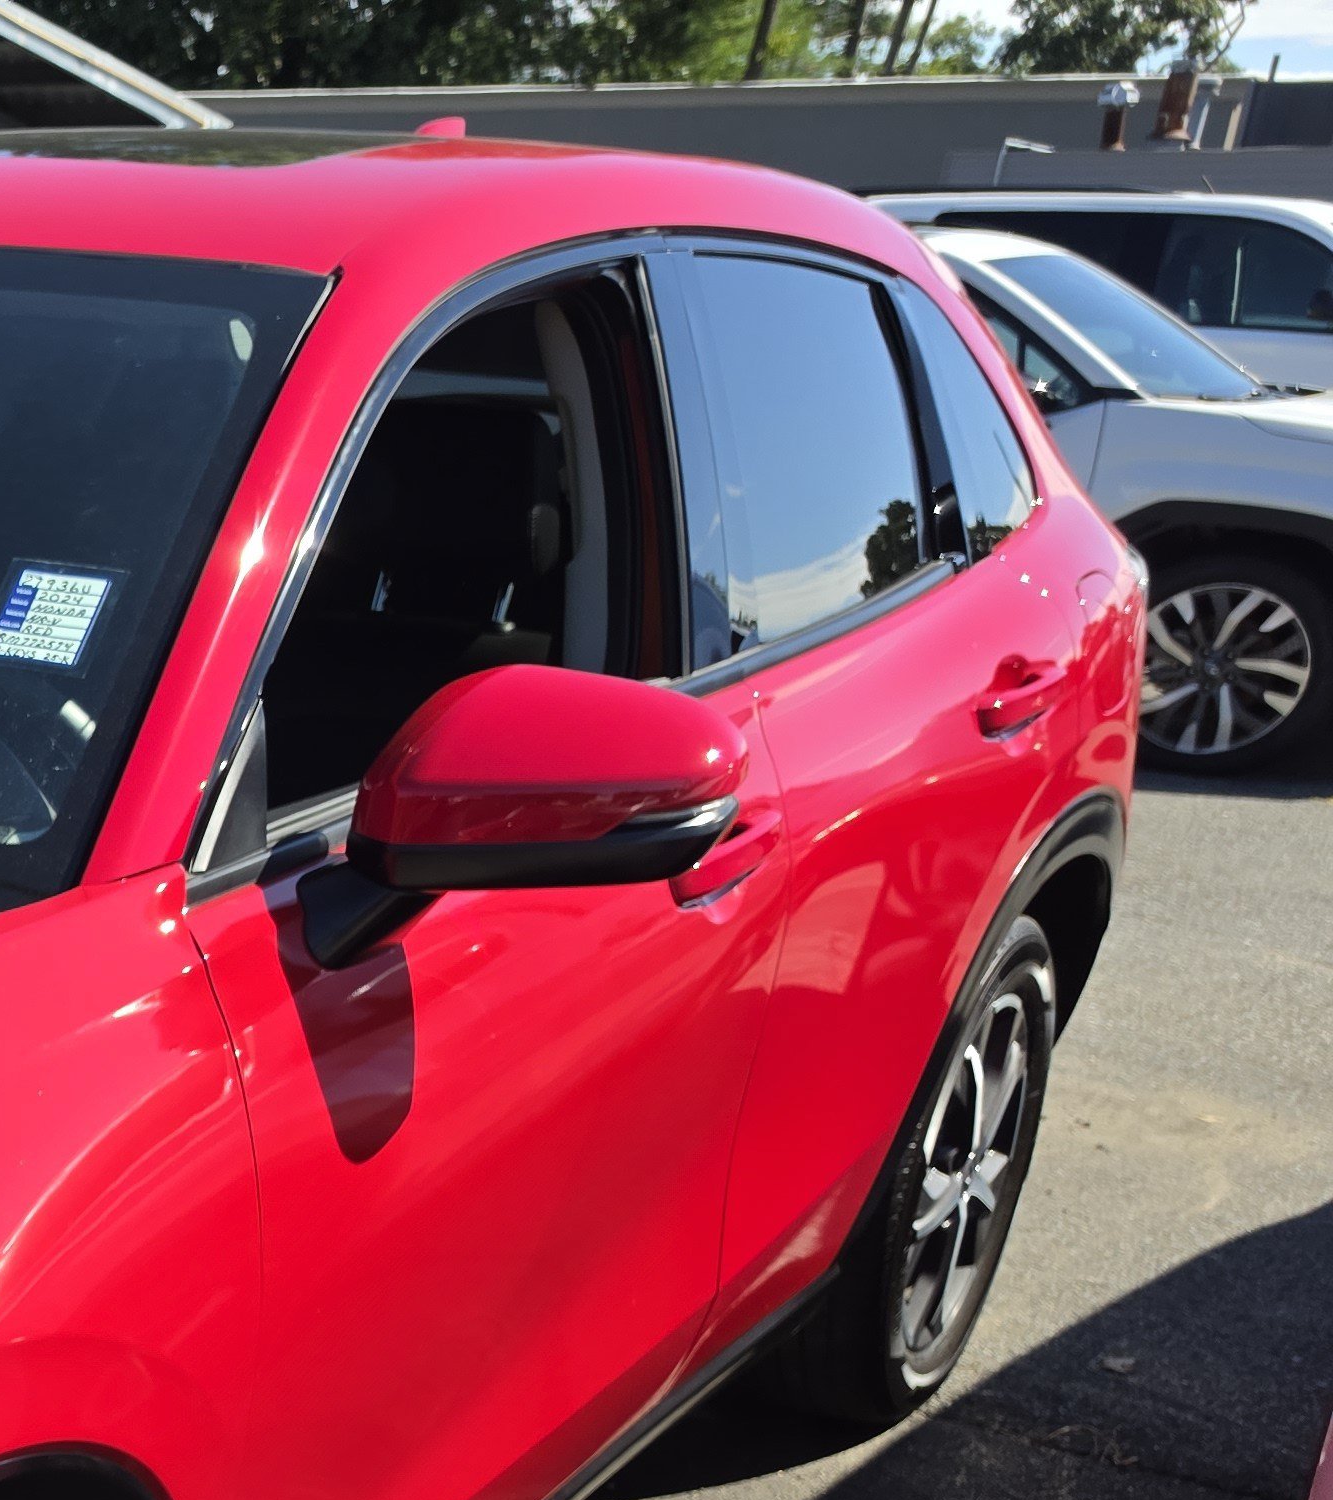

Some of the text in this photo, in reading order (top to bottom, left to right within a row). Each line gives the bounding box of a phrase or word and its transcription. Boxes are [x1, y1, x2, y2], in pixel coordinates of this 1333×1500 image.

[37, 592, 84, 605] 2024
[30, 604, 88, 618] HONDA
[21, 625, 53, 637] RED
